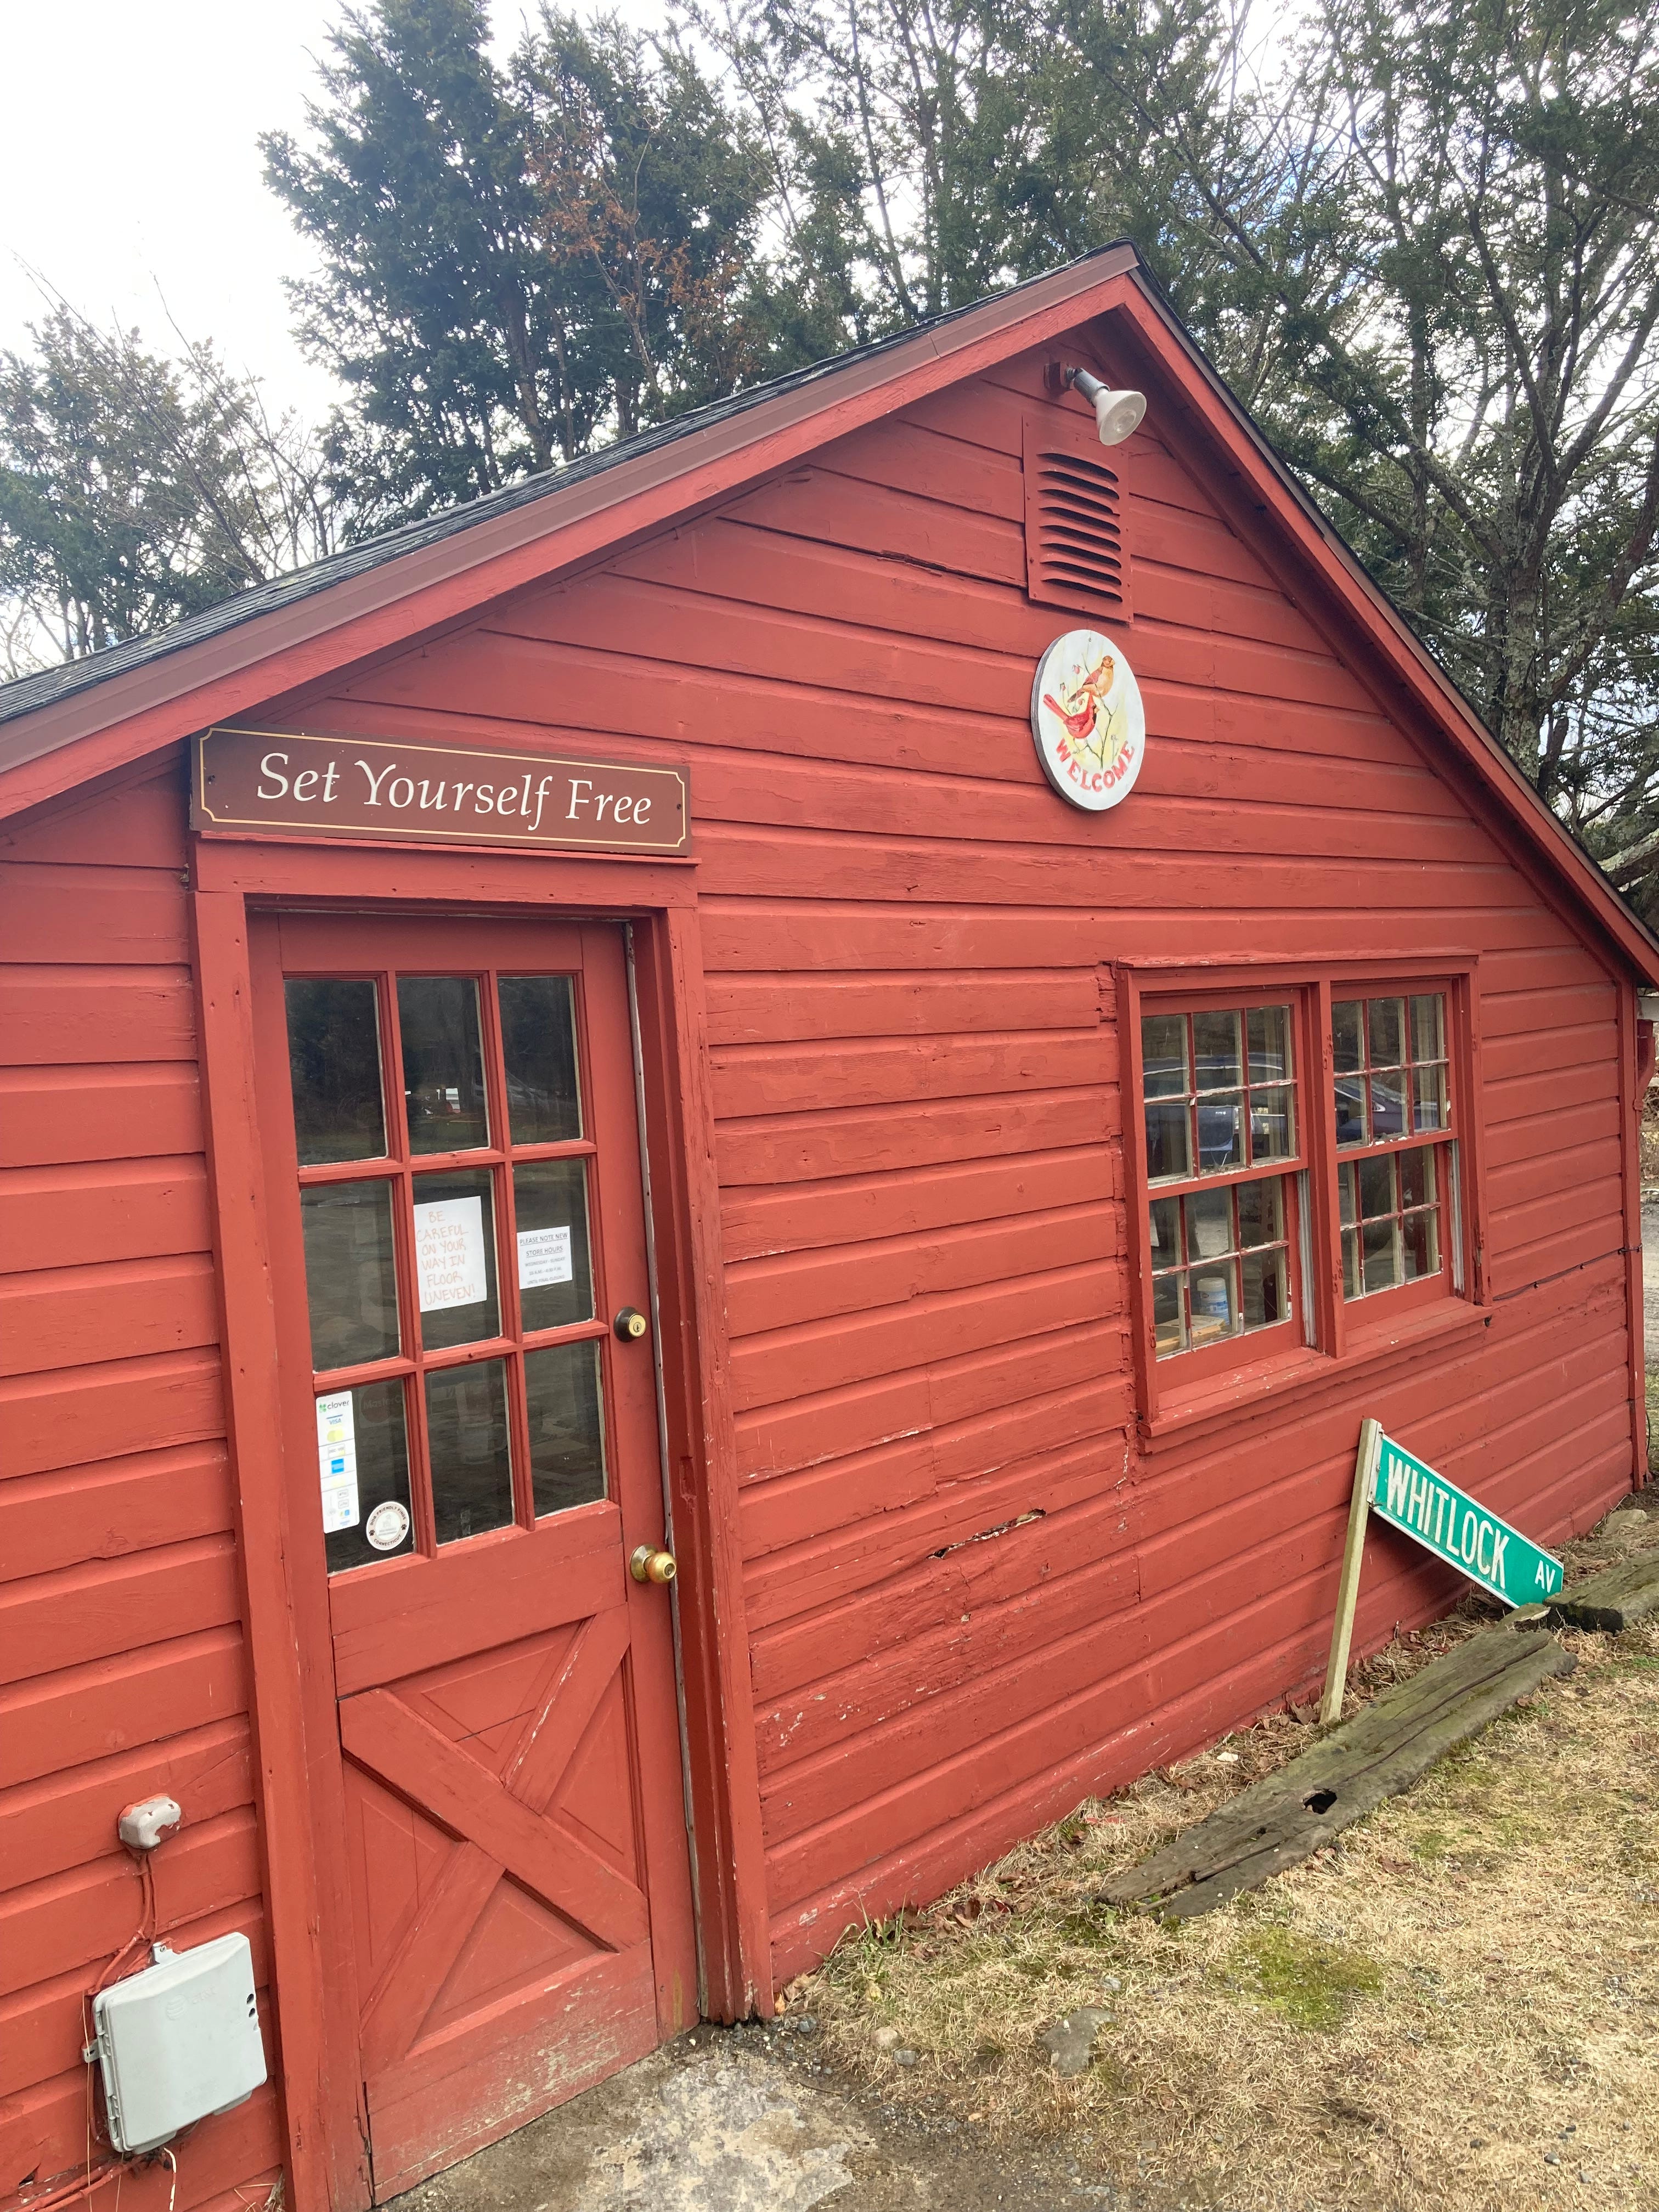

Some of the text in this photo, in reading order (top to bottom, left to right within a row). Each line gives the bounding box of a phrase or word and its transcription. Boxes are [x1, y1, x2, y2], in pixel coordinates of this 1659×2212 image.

[1056, 737, 1135, 792] WELCOME
[257, 753, 652, 831] Set Yourself Free
[428, 1210, 445, 1223] BE
[416, 1224, 469, 1242] CAREFUL
[520, 1236, 539, 1244] PLEASE
[421, 1238, 466, 1256] ON YOUR
[545, 1245, 563, 1254] HOURS
[421, 1254, 465, 1271] WAY IN
[426, 1271, 463, 1287] FLOOR
[424, 1283, 476, 1305] UNEVEN!
[327, 1400, 350, 1410] clover
[376, 1505, 397, 1516] FRIENDLY
[1386, 1453, 1555, 1593] WHITLOCK AV
[374, 1534, 402, 1546] CONNECTICUT
